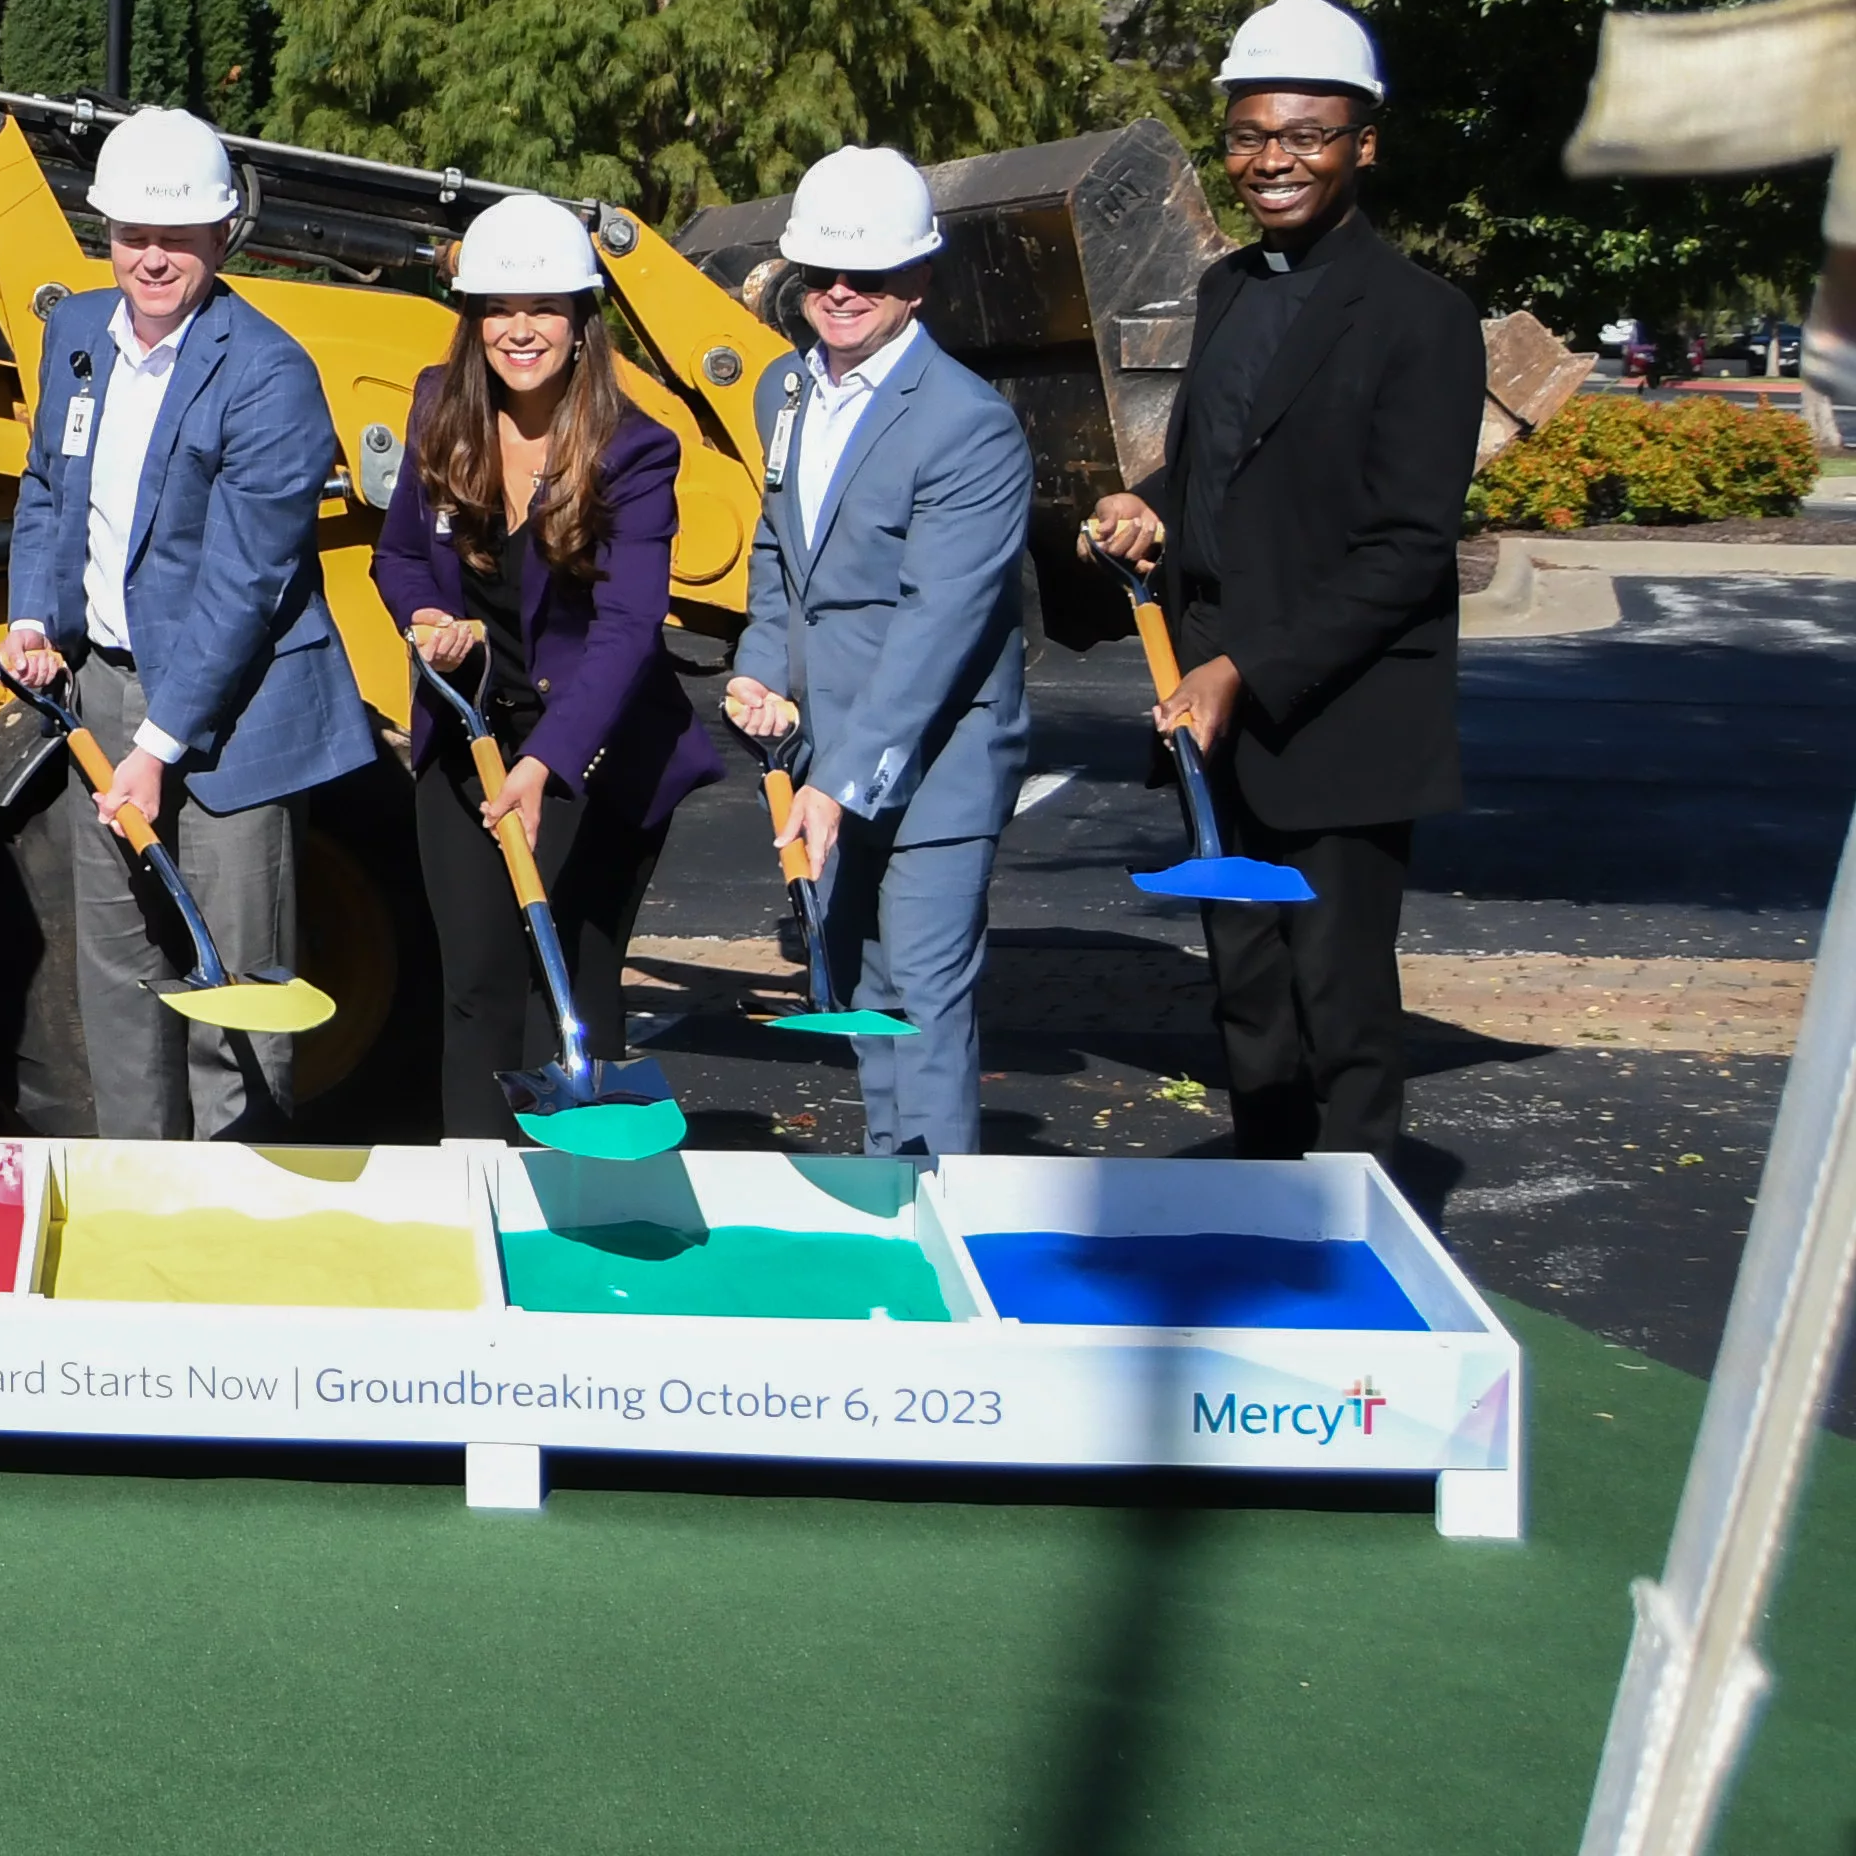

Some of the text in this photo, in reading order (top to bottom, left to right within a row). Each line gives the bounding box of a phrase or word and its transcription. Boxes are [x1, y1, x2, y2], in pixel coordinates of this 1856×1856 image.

[60, 1361, 173, 1399] Starts
[188, 1365, 279, 1401] Now
[315, 1367, 646, 1421] Groundbreaking
[659, 1378, 831, 1420] October
[844, 1387, 879, 1427] 6,
[893, 1388, 1002, 1426] 2023
[1193, 1391, 1345, 1445] Mercy
